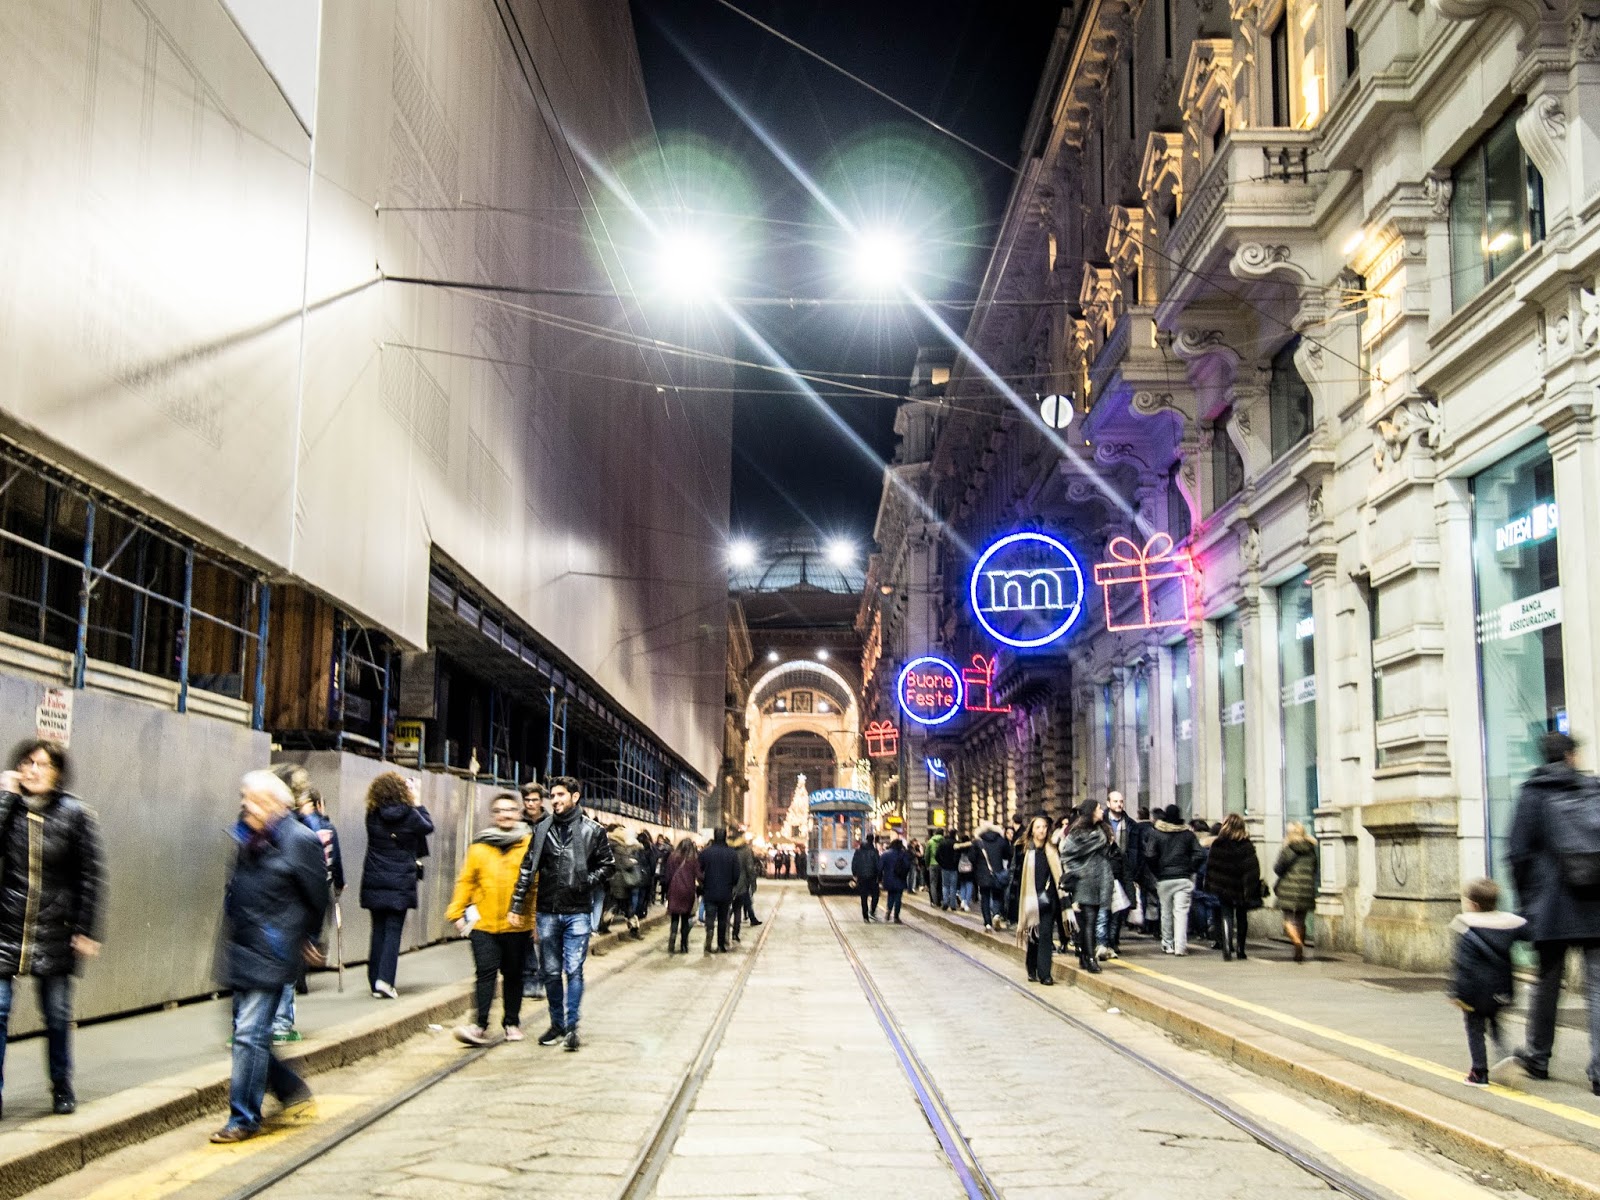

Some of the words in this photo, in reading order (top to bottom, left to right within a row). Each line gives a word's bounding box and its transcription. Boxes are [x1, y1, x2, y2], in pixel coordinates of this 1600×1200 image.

[1496, 515, 1532, 552] INTESA
[1548, 503, 1559, 530] S
[986, 568, 1064, 611] m
[1521, 599, 1542, 614] BANCA
[906, 670, 955, 689] Buone
[906, 687, 955, 707] Feste
[396, 726, 422, 738] LOTTO
